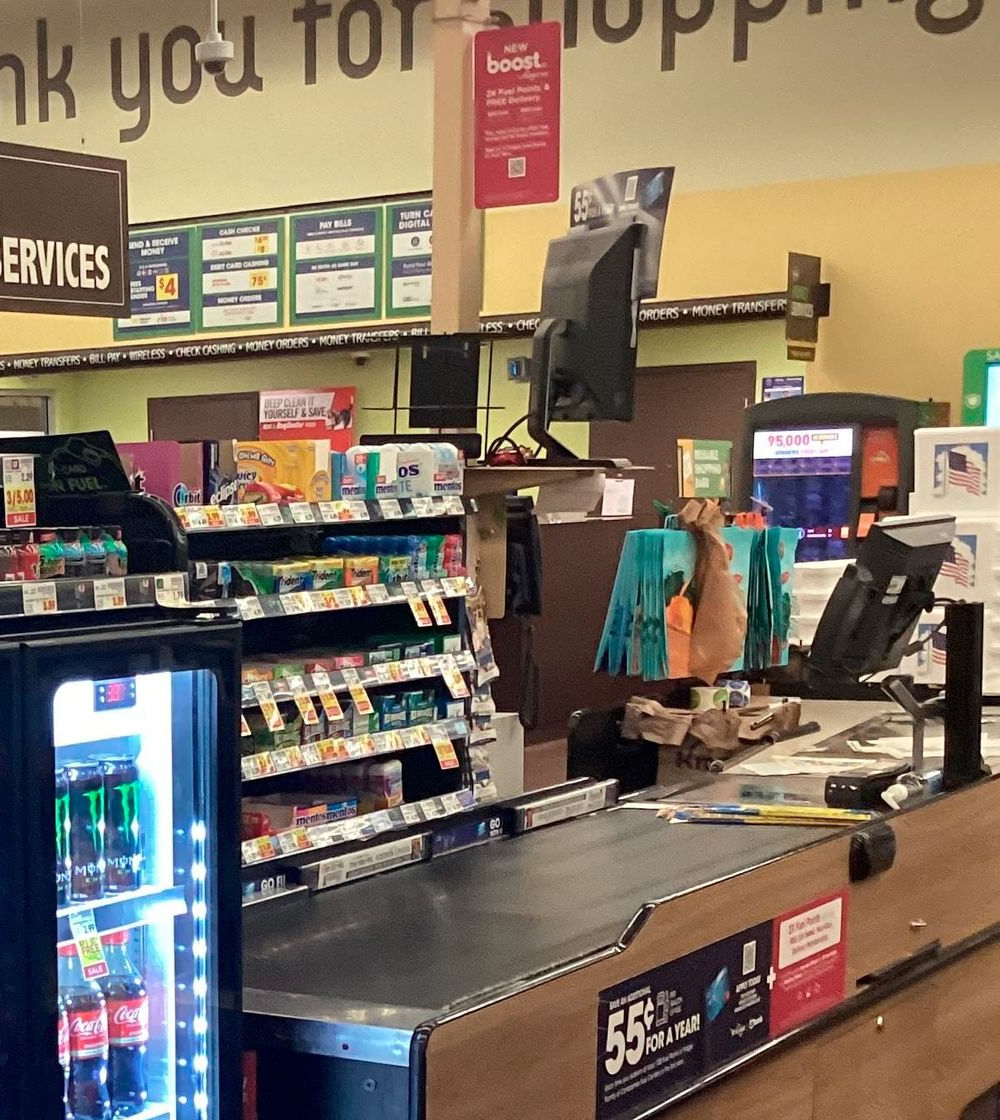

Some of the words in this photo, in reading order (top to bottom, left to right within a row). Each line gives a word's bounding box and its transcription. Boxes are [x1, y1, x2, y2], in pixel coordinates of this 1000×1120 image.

[487, 51, 542, 74] boost
[110, 15, 263, 142] you
[319, 220, 332, 230] PAY
[334, 219, 352, 229] BILLS
[398, 218, 430, 230] DIGITAL
[400, 211, 421, 221] TURN
[159, 278, 177, 297] $4
[639, 307, 680, 322] ORDERS
[692, 303, 729, 317] MONEY
[13, 358, 39, 370] MONEY
[40, 354, 81, 368] TRANSFERS
[89, 353, 106, 364] BILL
[107, 351, 121, 363] PAY
[129, 347, 165, 361] WIRELESS
[176, 345, 201, 358] CHECK
[202, 342, 236, 357] CASHING
[245, 339, 273, 352] MONEY
[274, 336, 309, 350] ORDERS
[319, 333, 350, 346] MONEY
[351, 330, 399, 345] TRANSFERS
[264, 398, 283, 409] DEEP
[284, 397, 307, 408] CLEAN
[308, 396, 315, 407] IT
[263, 408, 298, 420] YOURSELF
[301, 408, 307, 418] &
[308, 407, 326, 417] SAVE
[768, 434, 810, 447] 95,000
[398, 464, 420, 478] os
[6, 489, 34, 508] 3/5.00
[173, 482, 202, 506] Orbit
[13, 514, 29, 524] SALE
[279, 575, 305, 586] Trident
[312, 569, 338, 581] Trident
[351, 567, 372, 578] Trident
[296, 812, 326, 826] mentos
[326, 806, 357, 821] mentos
[261, 877, 275, 891] GO
[87, 967, 104, 977] SALE
[605, 997, 655, 1075] 55¢
[646, 1030, 665, 1056] FOR
[666, 1026, 674, 1046] A
[674, 1013, 700, 1041] YEAR!
